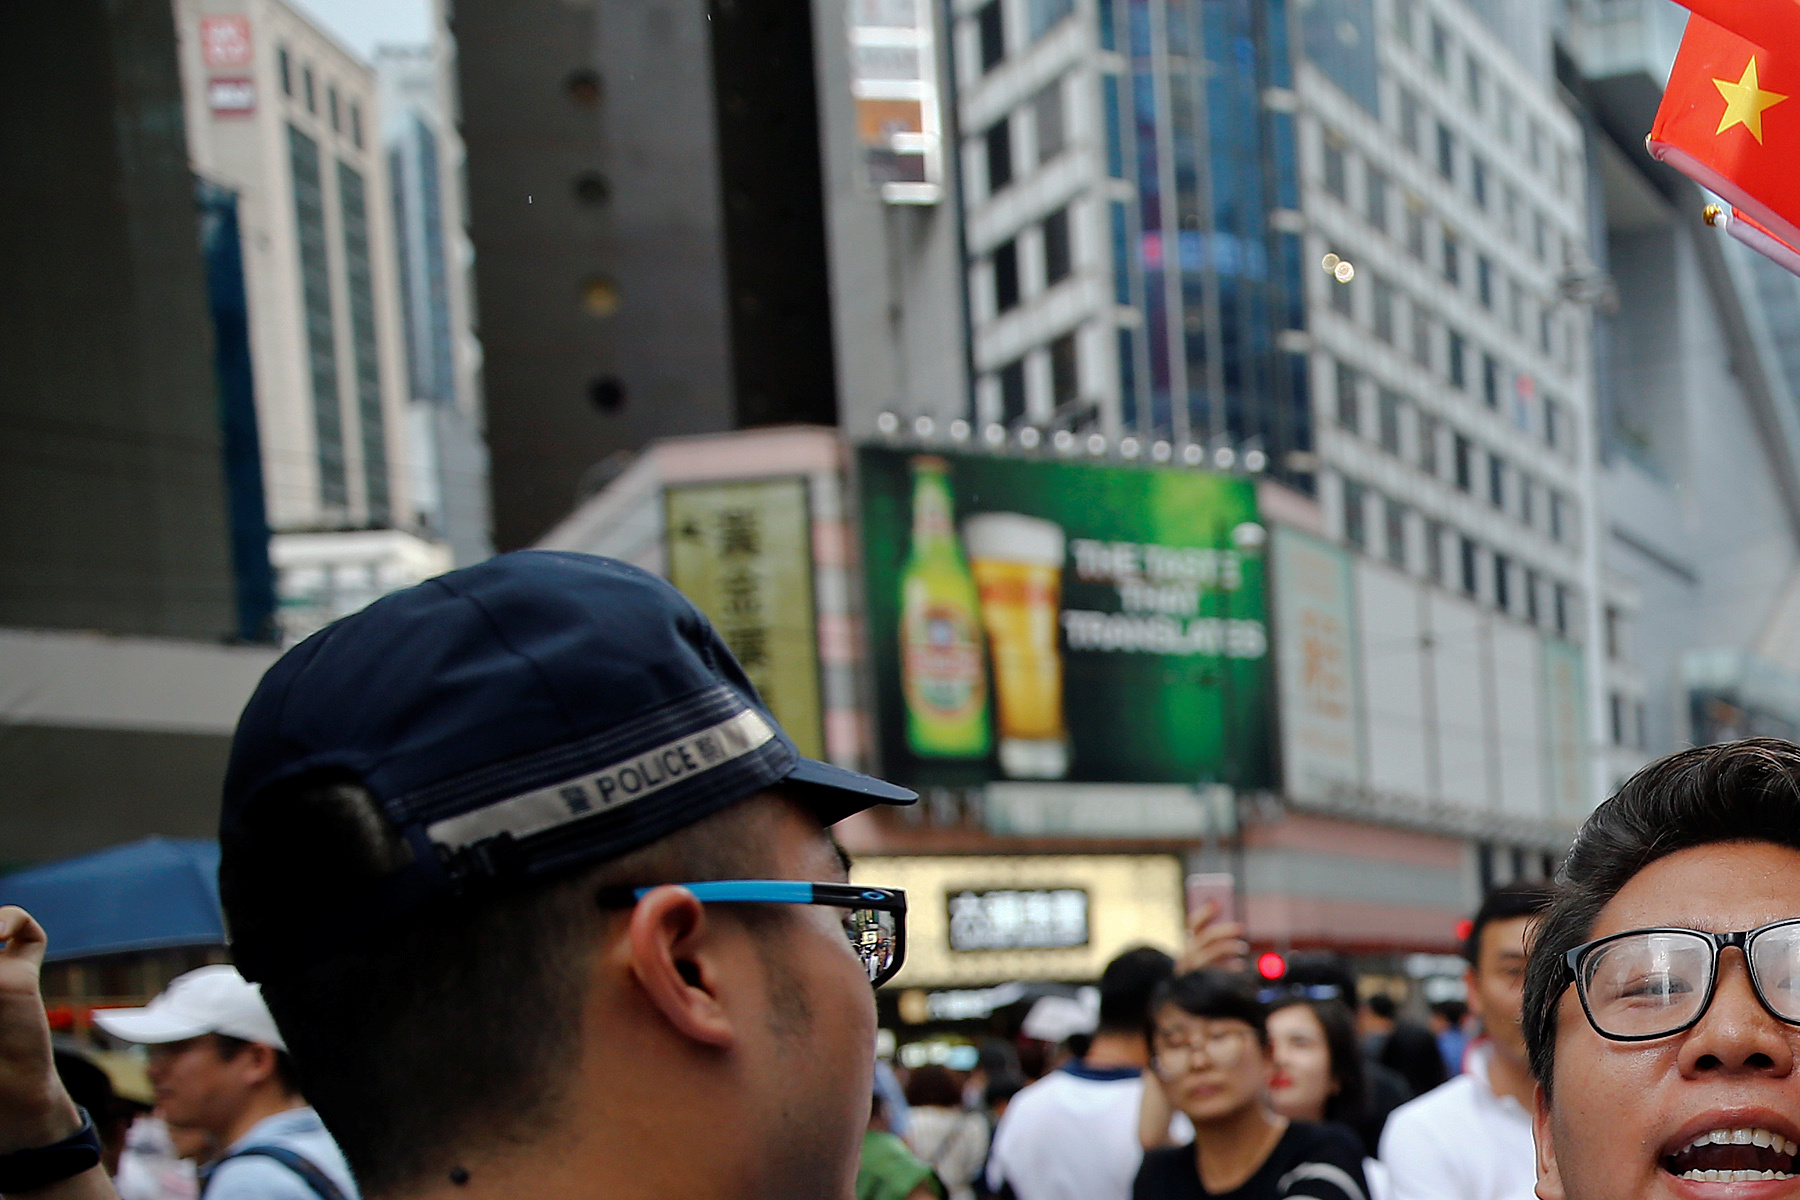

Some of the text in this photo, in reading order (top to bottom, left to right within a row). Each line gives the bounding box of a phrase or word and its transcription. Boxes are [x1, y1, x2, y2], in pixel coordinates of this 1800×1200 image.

[1073, 540, 1242, 588] THE TASTE
[1118, 579, 1198, 614] THAT
[1063, 611, 1266, 657] TRANSLATES
[595, 745, 698, 804] POLICE
